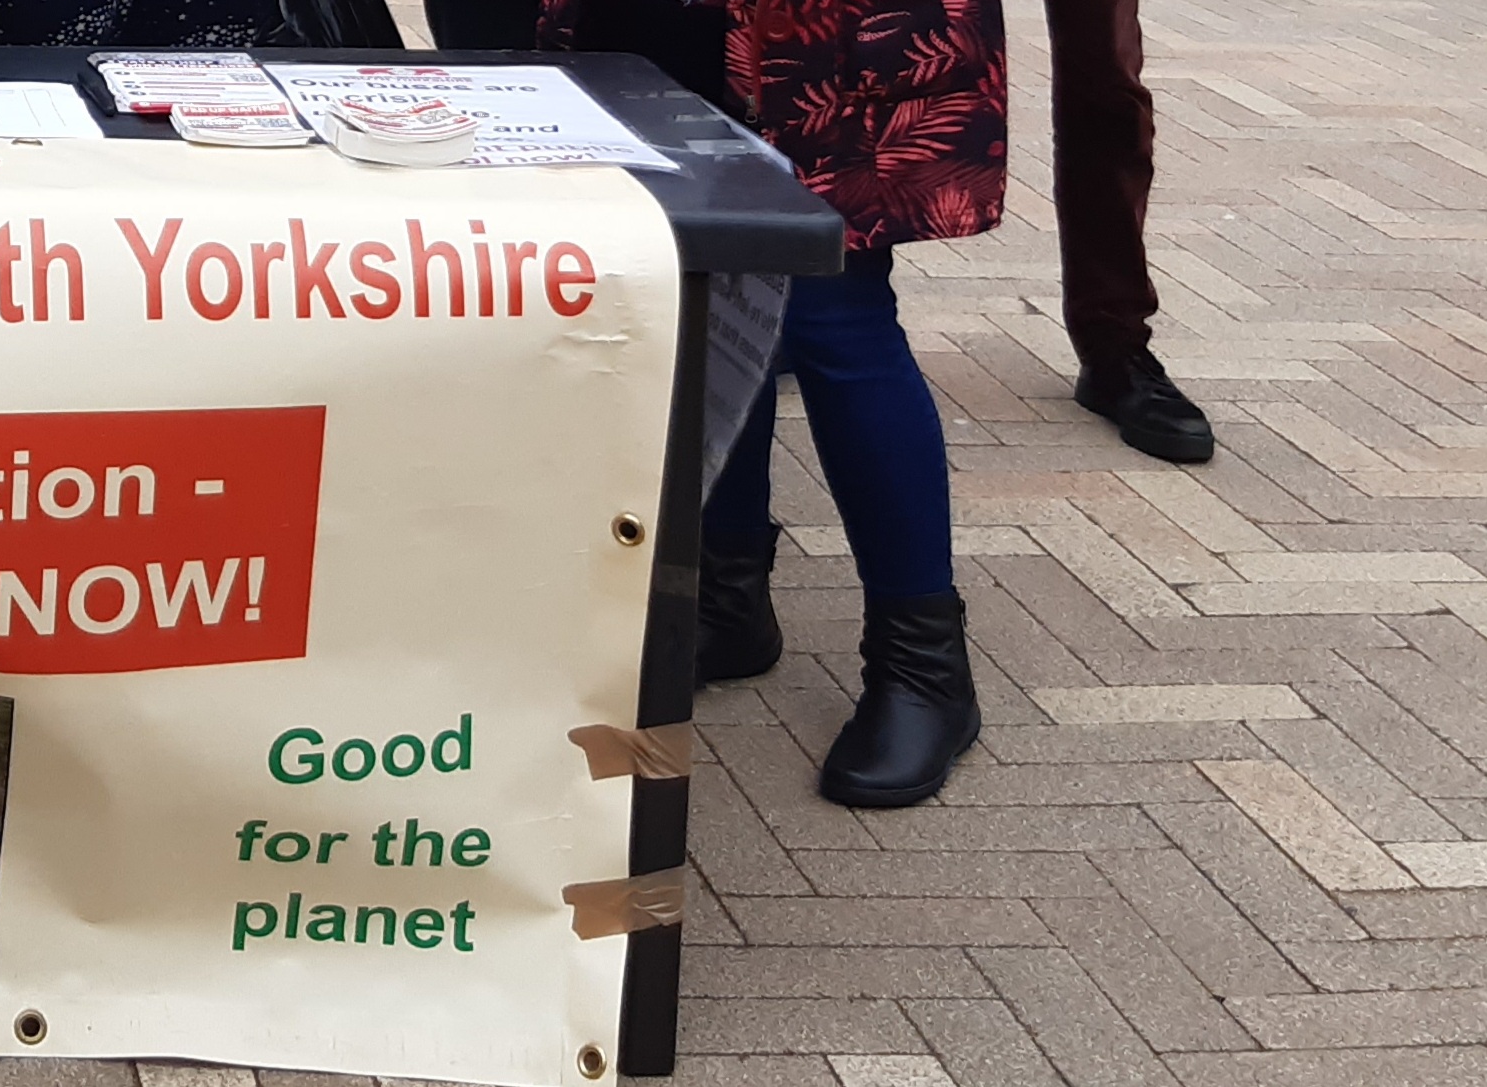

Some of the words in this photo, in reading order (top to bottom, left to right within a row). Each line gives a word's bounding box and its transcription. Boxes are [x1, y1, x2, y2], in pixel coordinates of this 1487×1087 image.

[290, 78, 357, 88] Our
[366, 81, 474, 91] buses
[485, 84, 539, 92] are
[299, 91, 329, 102] in
[493, 124, 559, 133] and
[505, 152, 598, 163] now!
[114, 216, 597, 321] Yorkshire
[268, 712, 472, 785] Good
[235, 819, 349, 864] for
[372, 818, 491, 867] the
[232, 892, 476, 952] planet
